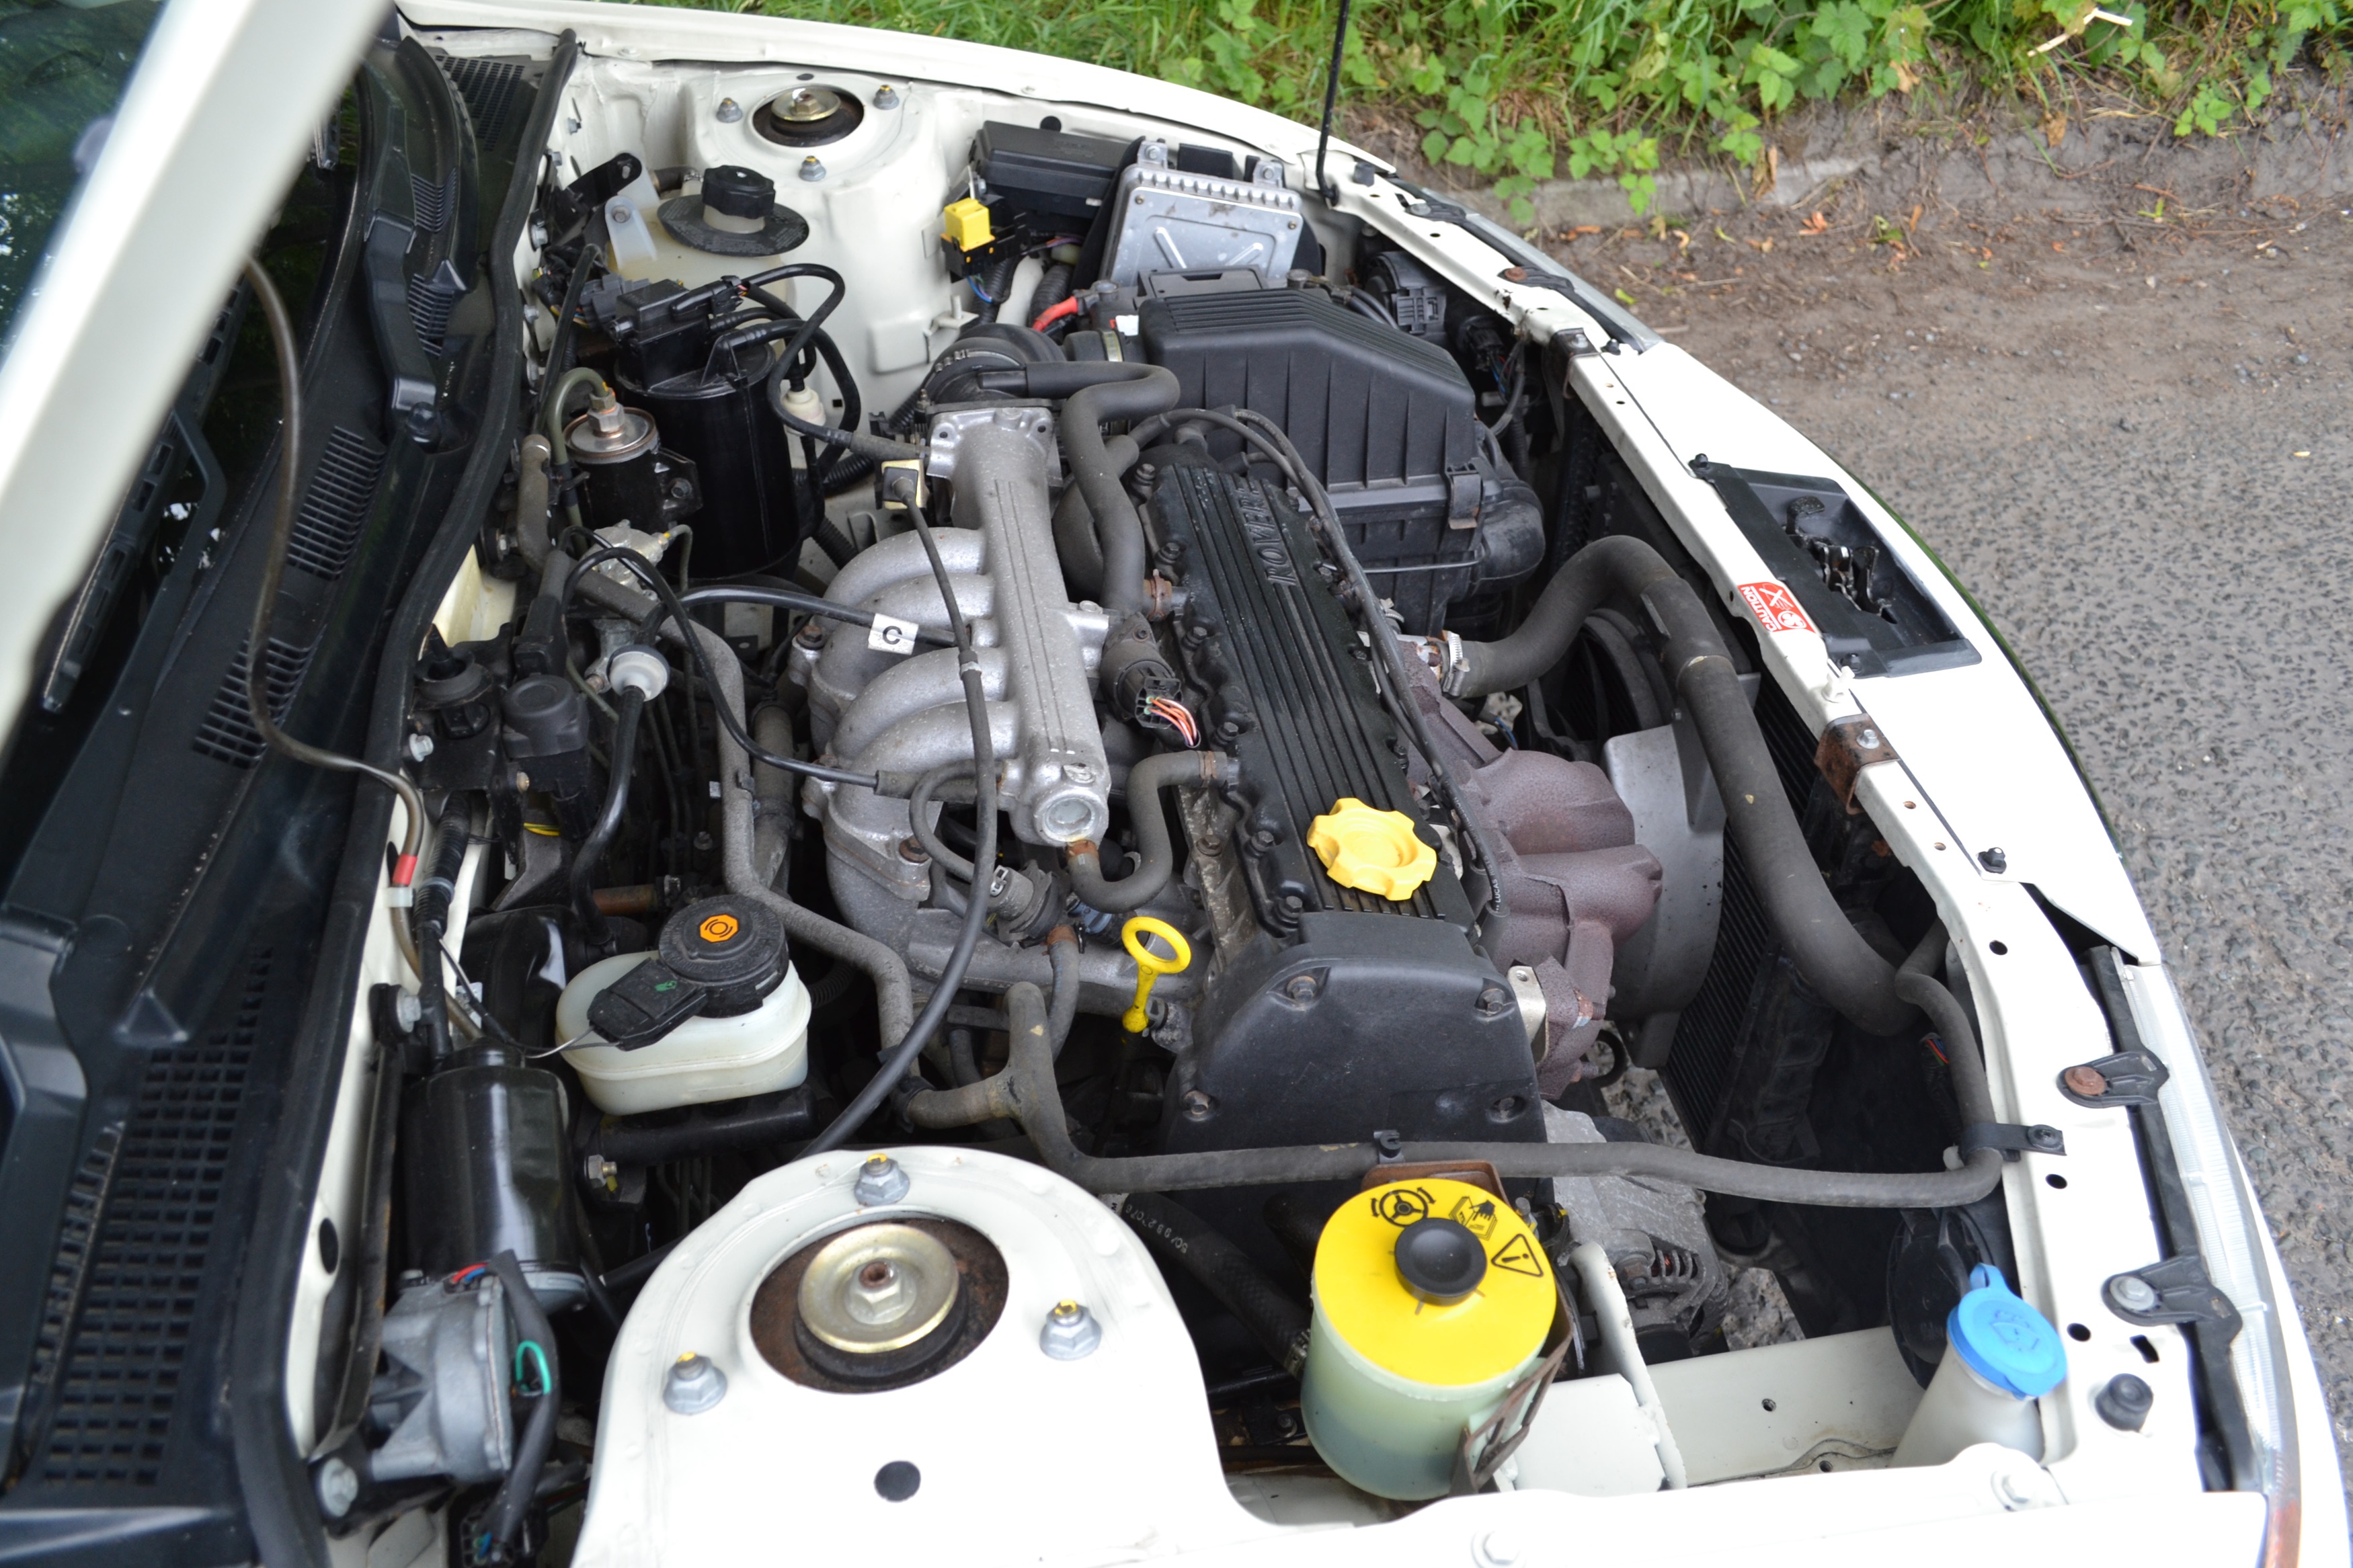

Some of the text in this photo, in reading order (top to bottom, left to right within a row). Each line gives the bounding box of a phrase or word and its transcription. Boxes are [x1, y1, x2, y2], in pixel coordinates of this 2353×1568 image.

[1238, 498, 1297, 586] ROVER
[1741, 586, 1777, 632] CAUTION
[883, 626, 902, 645] C
[1492, 878, 1501, 903] LUCAS
